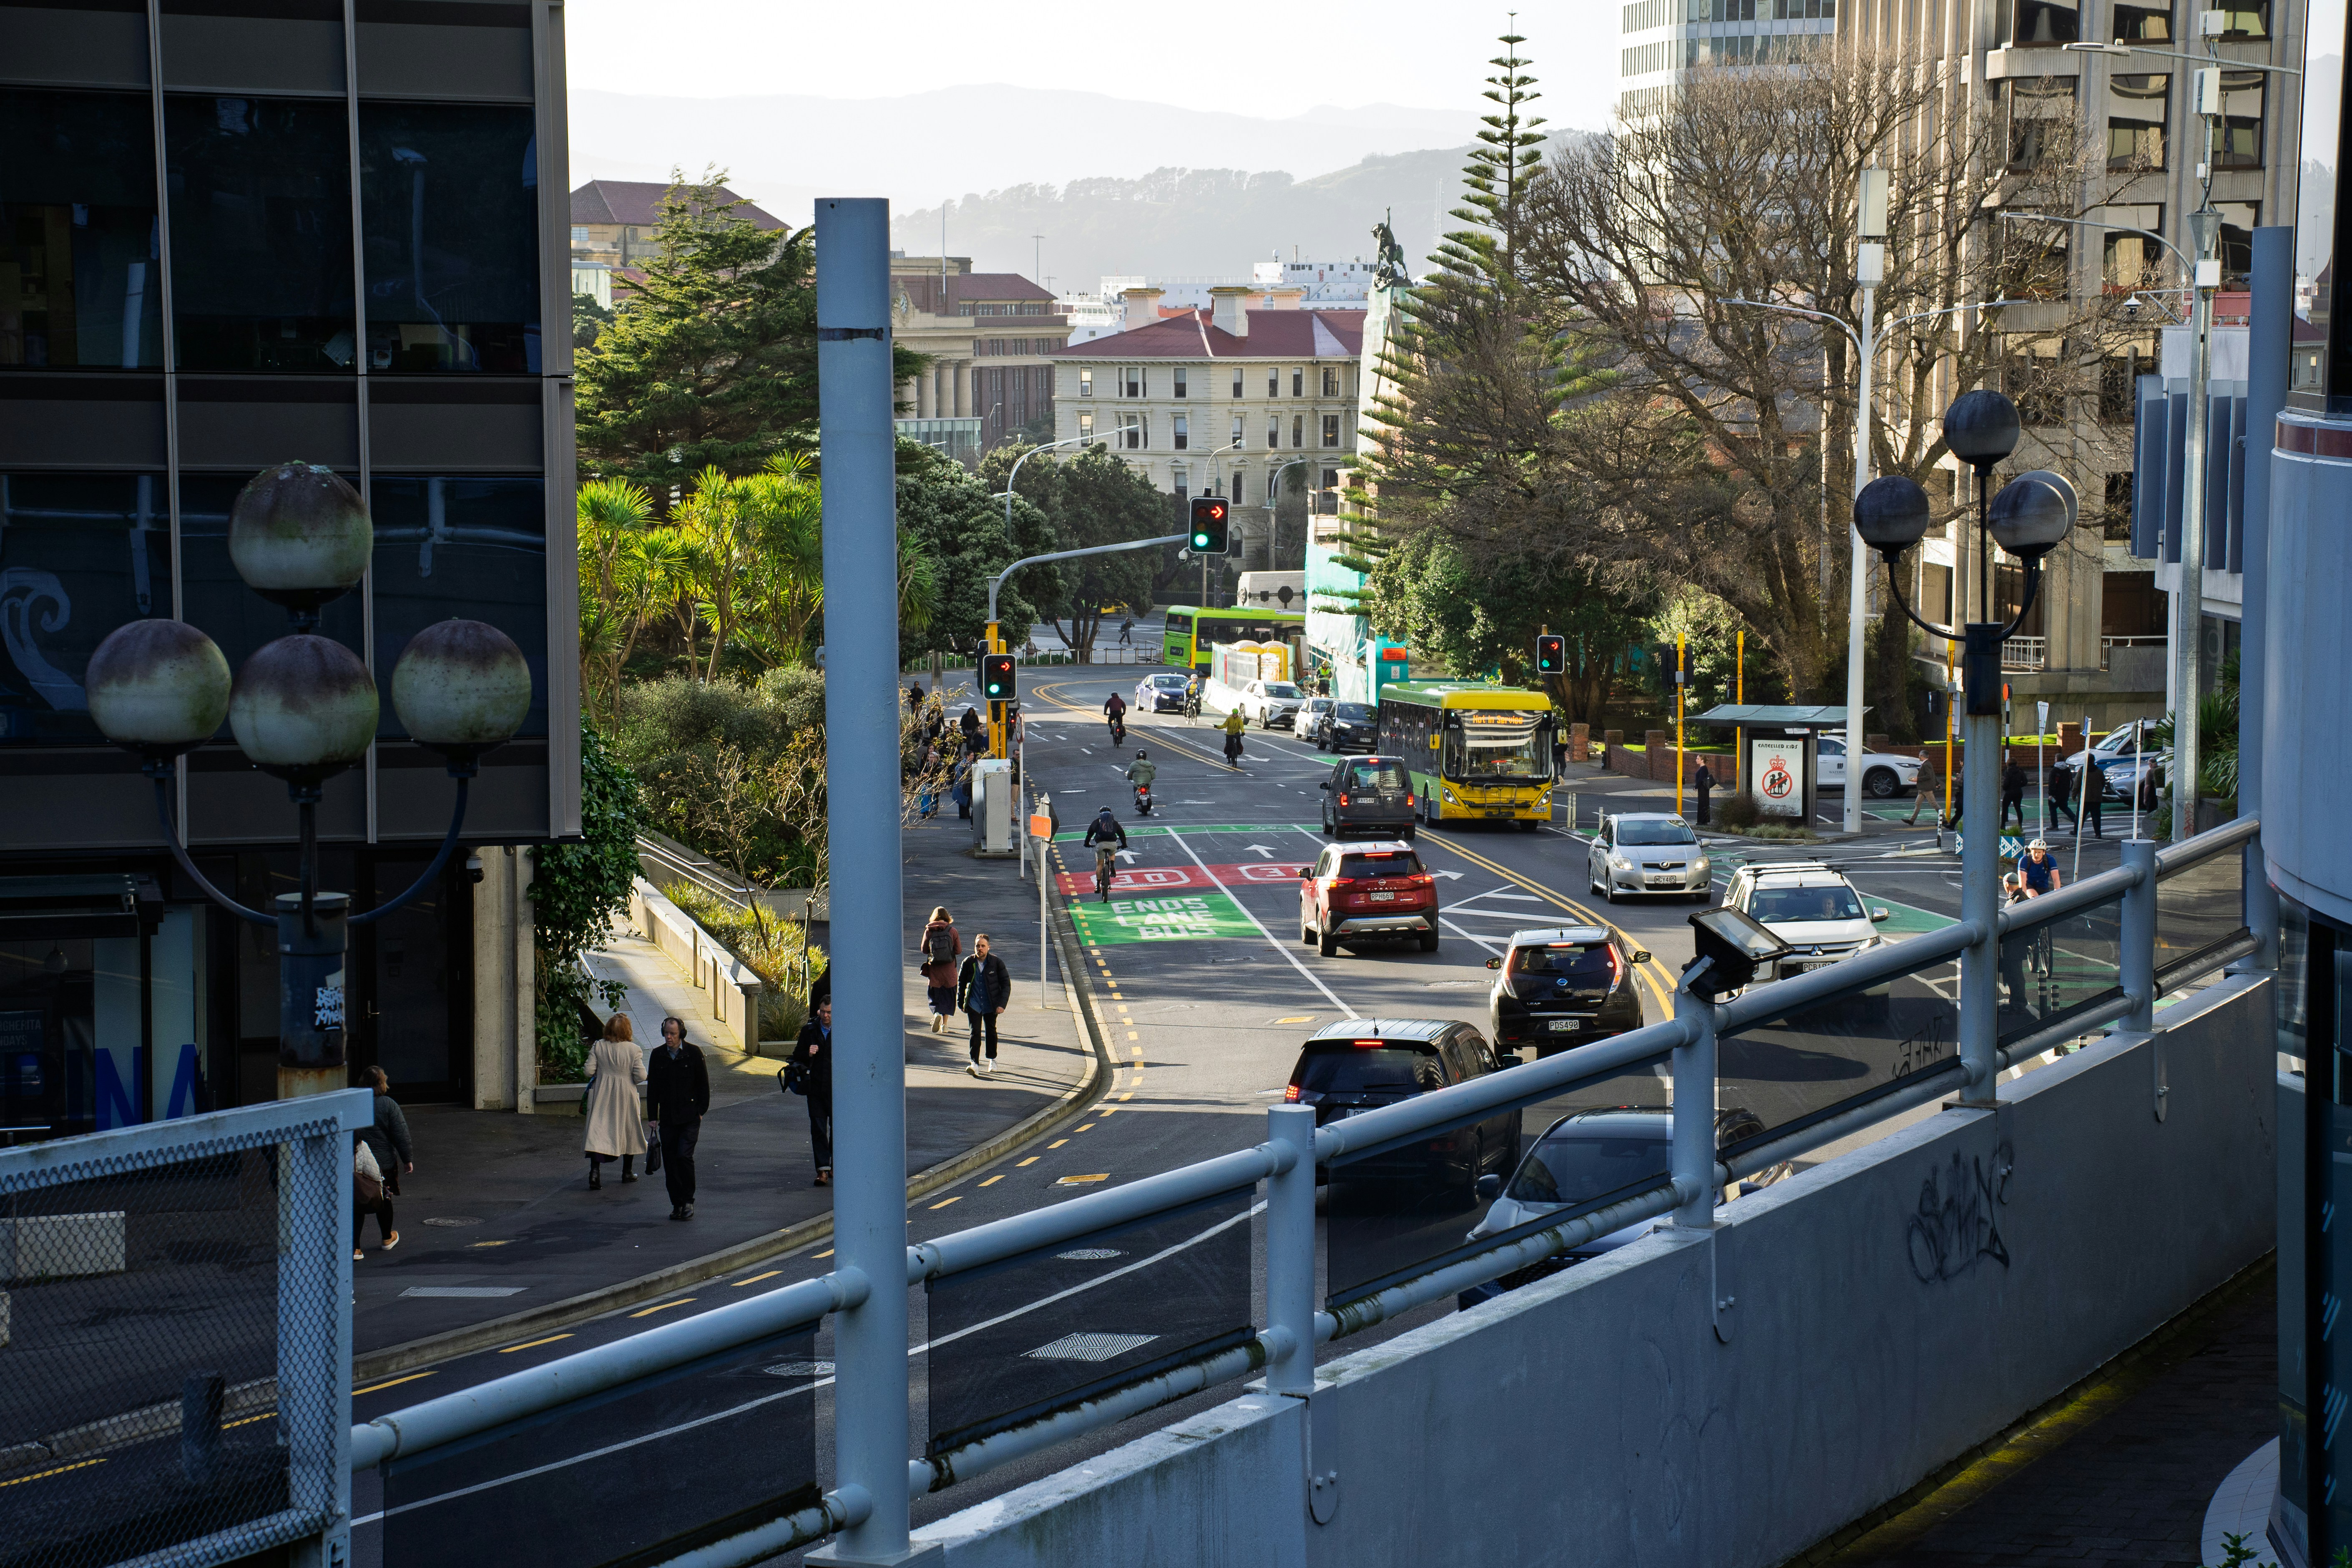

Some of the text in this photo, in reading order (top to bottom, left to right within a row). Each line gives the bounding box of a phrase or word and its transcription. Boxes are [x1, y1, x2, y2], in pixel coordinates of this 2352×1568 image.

[1497, 715, 1523, 724] Service
[1111, 898, 1209, 914] ENDS
[1115, 910, 1217, 927] LANE
[1138, 923, 1217, 939] BUS
[1550, 1020, 1578, 1029] PDS490
